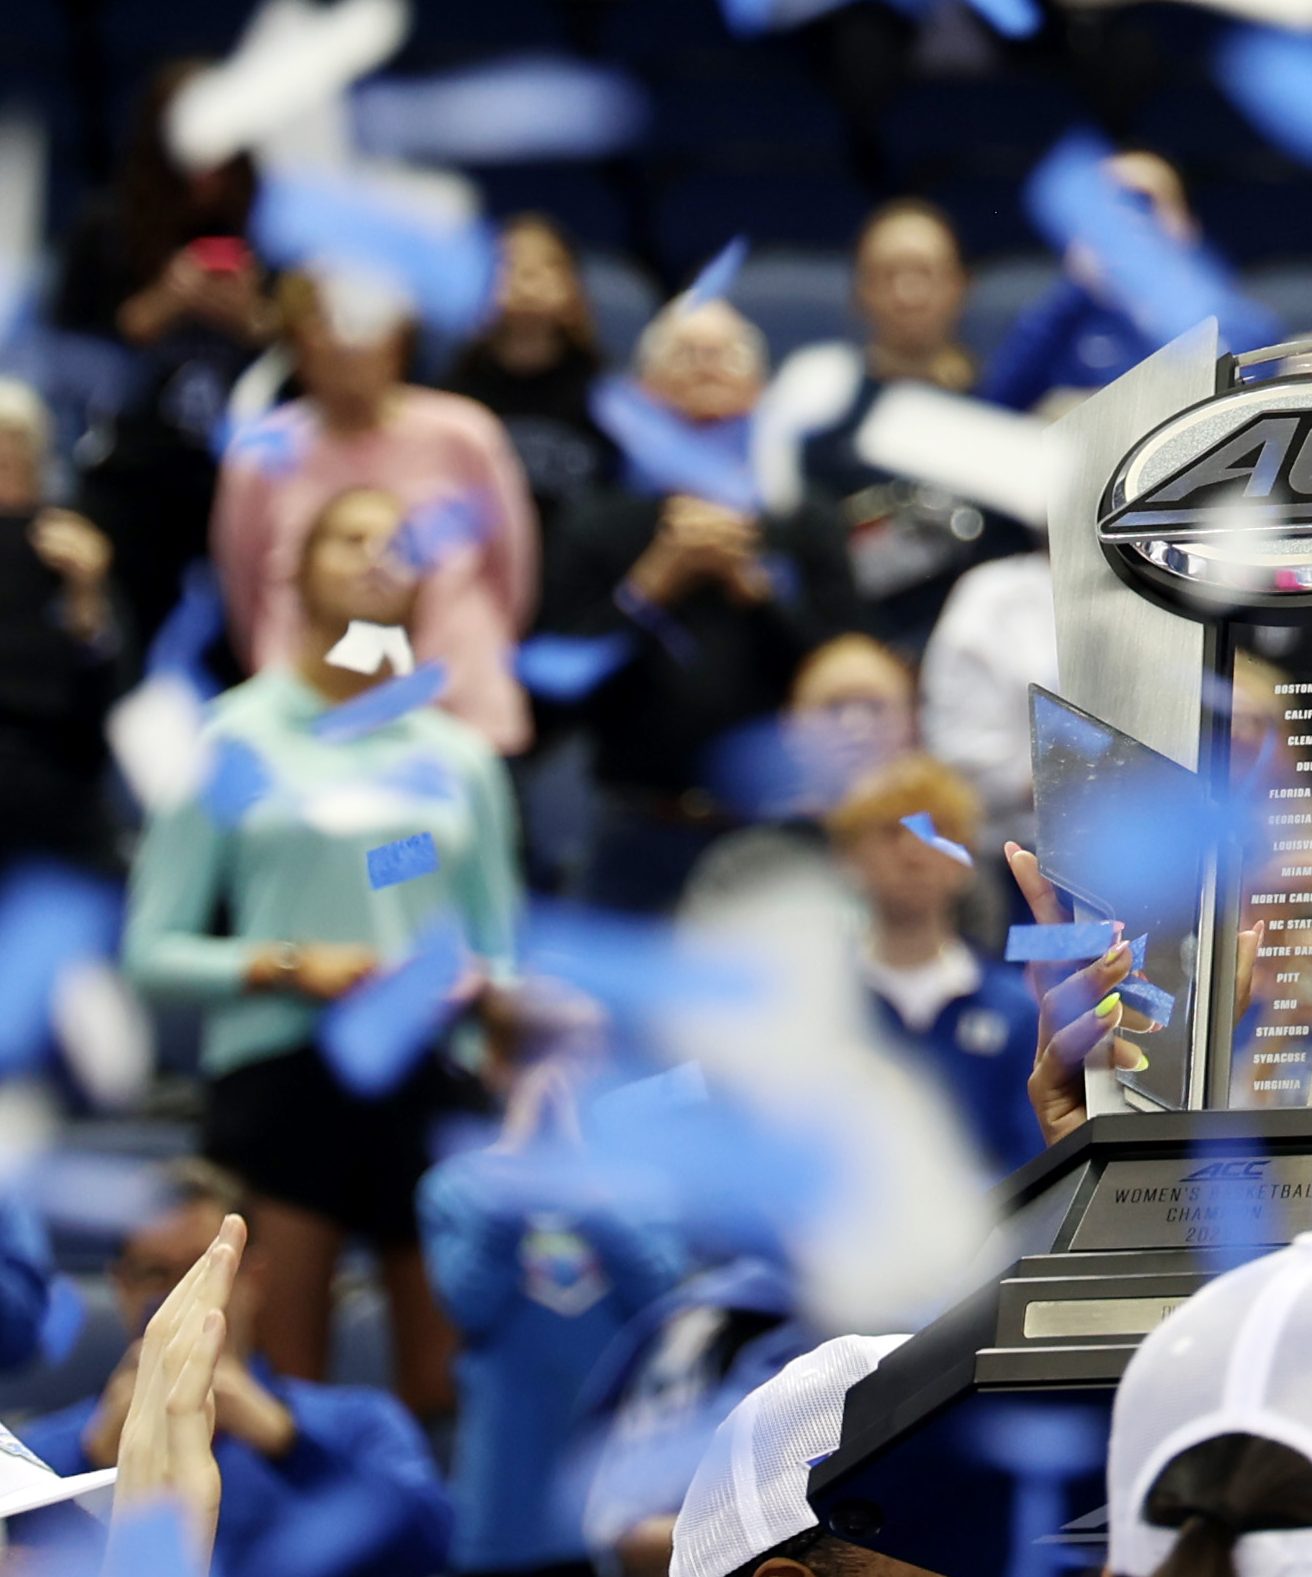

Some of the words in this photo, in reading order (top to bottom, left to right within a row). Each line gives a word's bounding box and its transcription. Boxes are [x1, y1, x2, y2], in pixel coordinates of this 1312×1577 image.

[1268, 788, 1311, 799] FLORIDA
[1267, 814, 1312, 825] GEORGIA
[1250, 893, 1287, 905] NORTH
[1268, 920, 1285, 931] NC
[1257, 946, 1292, 957] NOTRE
[1276, 972, 1300, 983] PITT
[1273, 999, 1298, 1010] SMU
[1255, 1025, 1310, 1037] STANFORD
[1252, 1052, 1308, 1064] SYRACUSE
[1253, 1079, 1301, 1091] VIRGINIA
[1186, 1160, 1273, 1179] ACC
[1115, 1187, 1200, 1204] WOMEN'S
[1166, 1205, 1263, 1223] CHAMN
[1185, 1226, 1230, 1243] 202
